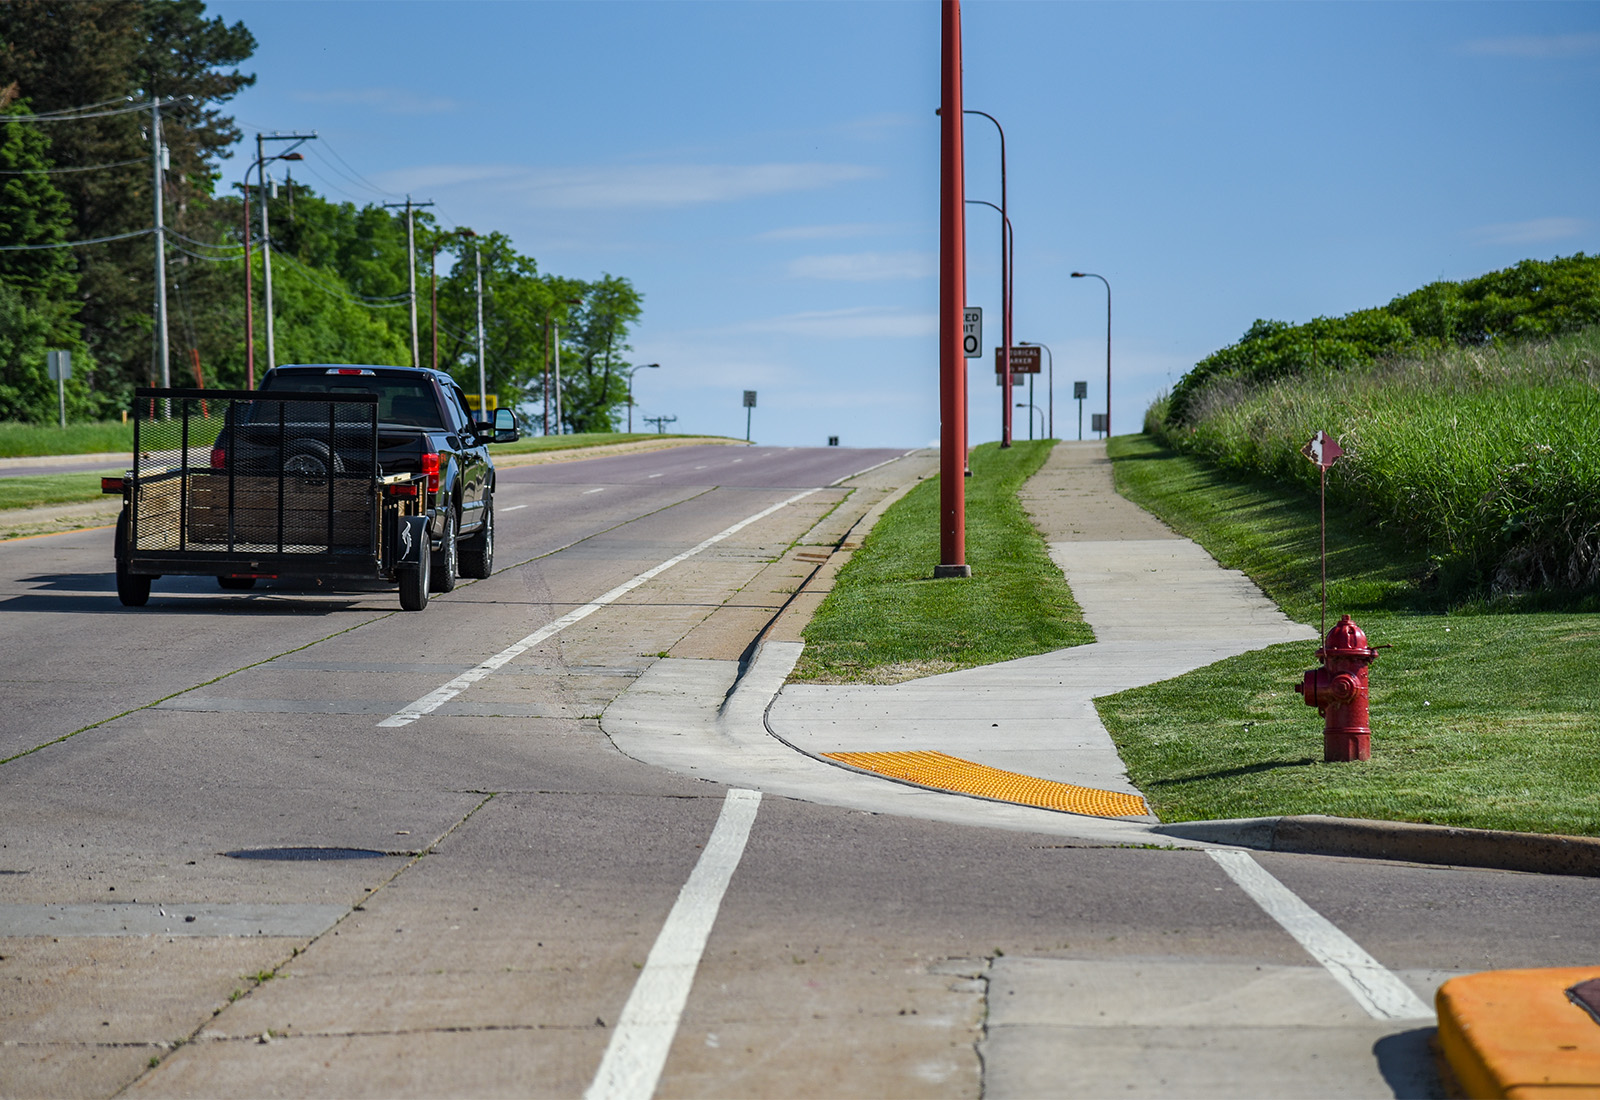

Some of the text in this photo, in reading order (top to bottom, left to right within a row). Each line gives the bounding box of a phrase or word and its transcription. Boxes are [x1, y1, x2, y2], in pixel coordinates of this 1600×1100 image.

[963, 313, 978, 322] ED
[963, 324, 974, 332] IT
[964, 335, 978, 353] 0
